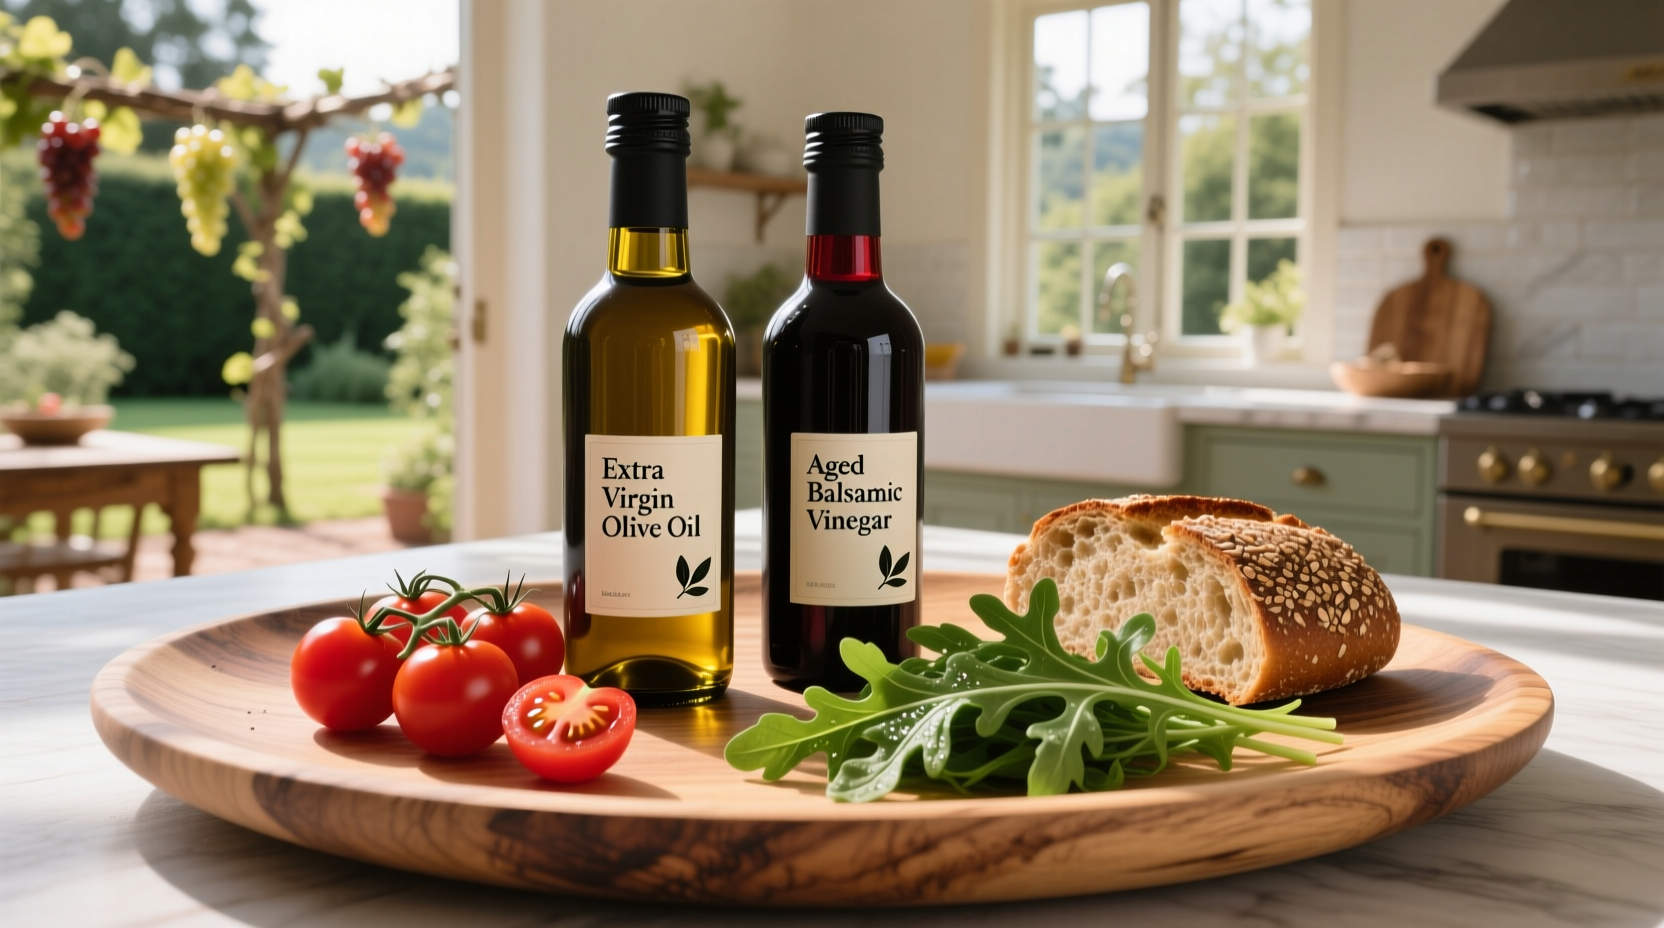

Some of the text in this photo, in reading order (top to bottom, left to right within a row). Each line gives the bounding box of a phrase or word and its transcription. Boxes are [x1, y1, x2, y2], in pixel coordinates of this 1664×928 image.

[602, 457, 665, 480] Extra
[806, 454, 865, 482] Aged
[602, 487, 674, 516] Virgin
[806, 481, 903, 503] Balsamic
[602, 515, 701, 538] Olive Oil
[806, 509, 892, 536] Vinegar
